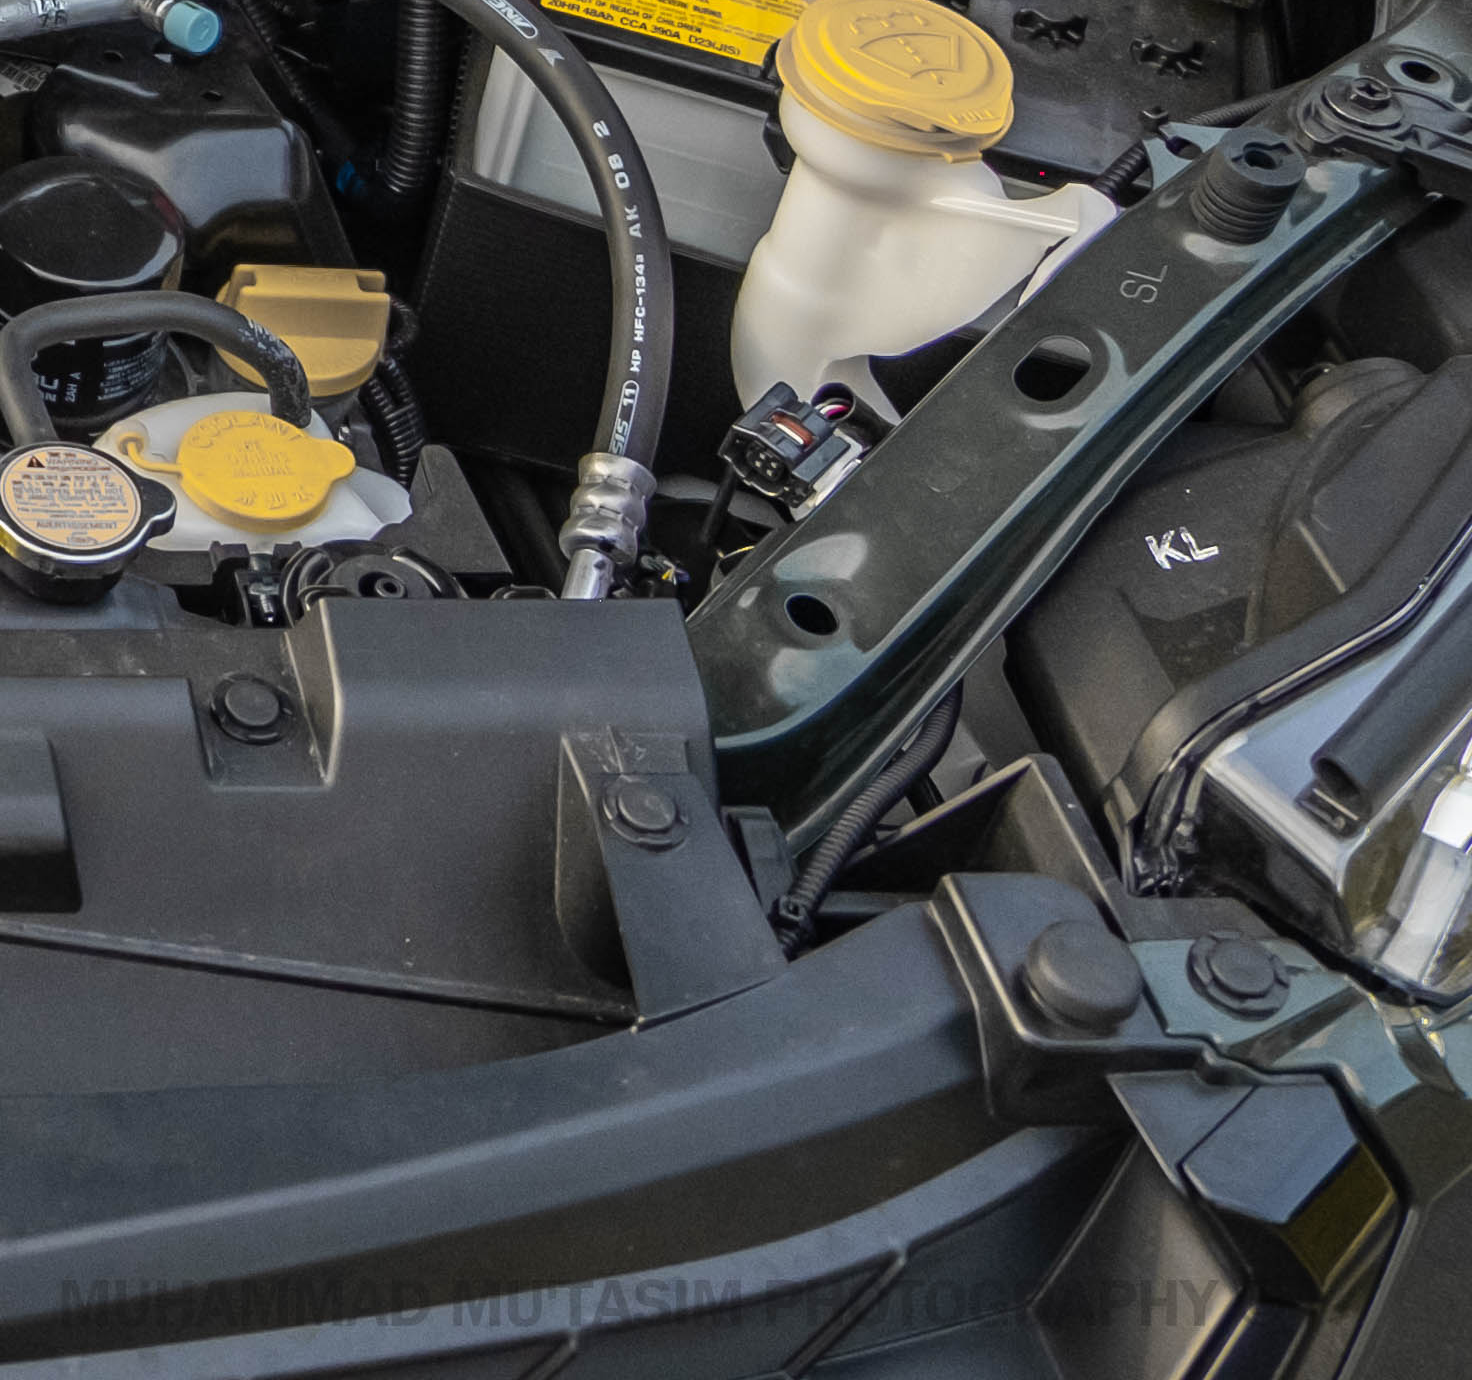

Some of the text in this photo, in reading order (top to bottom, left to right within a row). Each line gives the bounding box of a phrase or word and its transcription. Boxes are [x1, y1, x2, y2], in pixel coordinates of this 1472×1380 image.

[619, 16, 648, 31] CCA
[592, 119, 611, 138] 2
[625, 204, 643, 238] AK
[1119, 264, 1169, 304] SL
[629, 349, 643, 372] HP
[1145, 526, 1219, 570] KL
